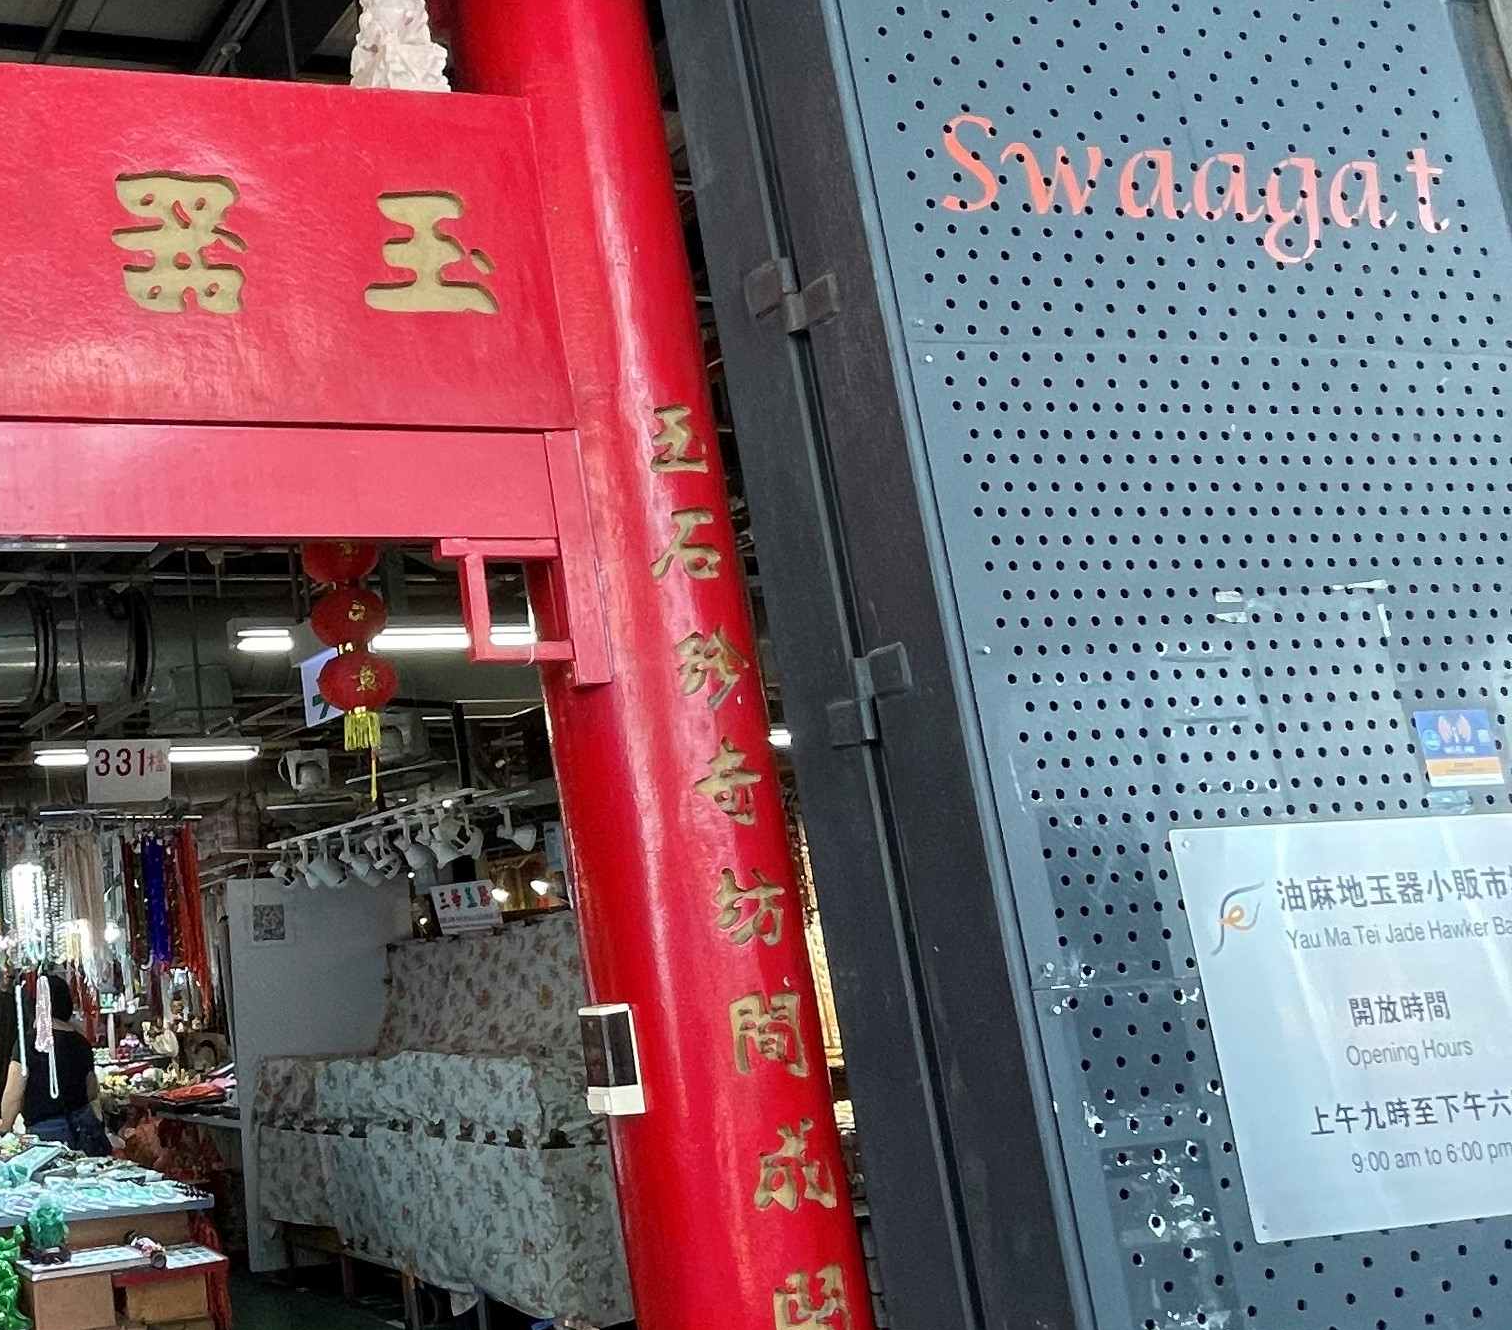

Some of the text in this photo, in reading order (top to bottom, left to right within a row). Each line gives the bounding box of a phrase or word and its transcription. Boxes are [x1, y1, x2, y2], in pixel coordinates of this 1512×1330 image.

[940, 113, 1452, 263] Swaagat
[1276, 865, 1512, 912] 油麻地玉器小販市
[1285, 929, 1320, 950] Yau
[1324, 927, 1352, 947] Ma
[1353, 924, 1380, 945] Tei
[1386, 922, 1425, 945] Jade
[1427, 918, 1489, 941] Hawker
[1347, 990, 1451, 1028] 開放時間
[1346, 1038, 1473, 1069] Opening Hours
[1351, 1150, 1390, 1174] 9:00
[1395, 1151, 1421, 1169] am
[1425, 1145, 1442, 1166] to
[1446, 1140, 1483, 1164] 6:00
